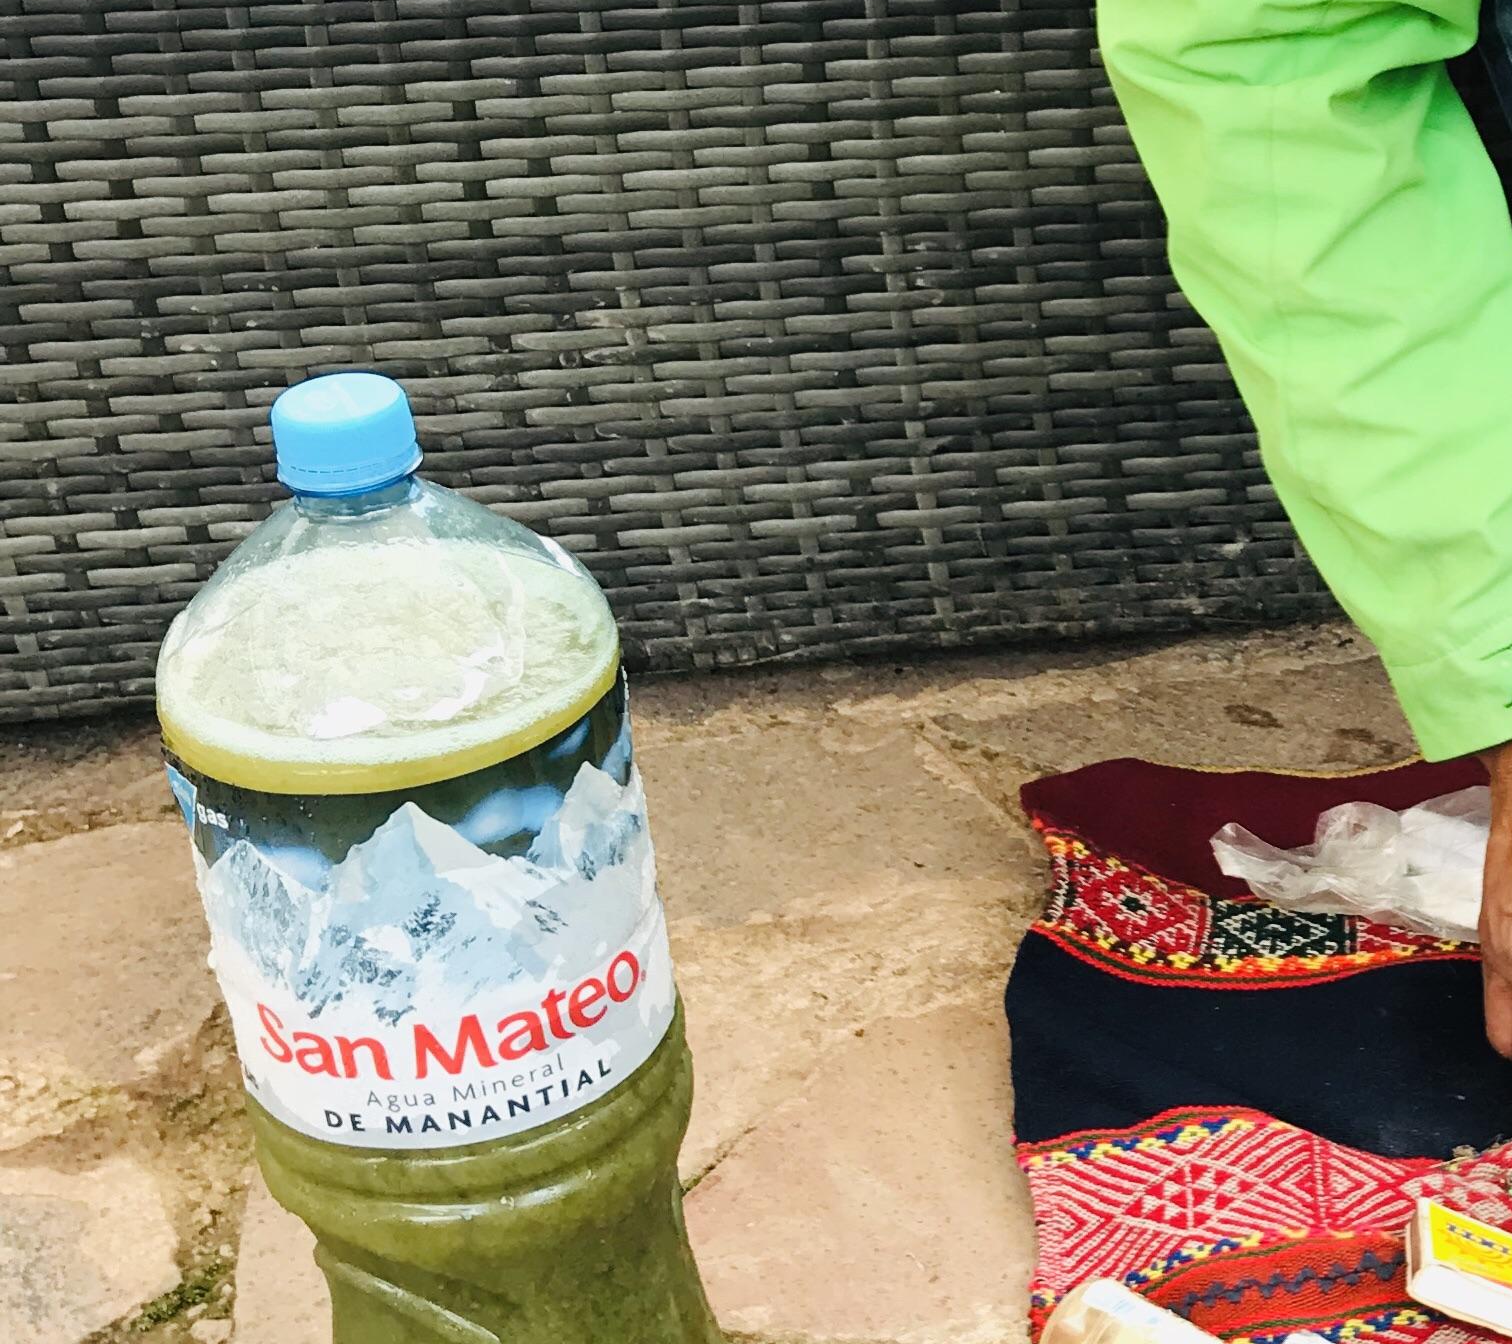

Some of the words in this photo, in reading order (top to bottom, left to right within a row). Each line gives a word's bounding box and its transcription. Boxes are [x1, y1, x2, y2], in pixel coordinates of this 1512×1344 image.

[195, 801, 229, 830] gas
[256, 1000, 393, 1081] San
[412, 950, 641, 1079] Mateo
[324, 1109, 366, 1133] DE
[386, 1059, 613, 1134] MANANTIAL
[366, 1088, 436, 1113] Agua
[452, 1053, 565, 1103] Mineral
